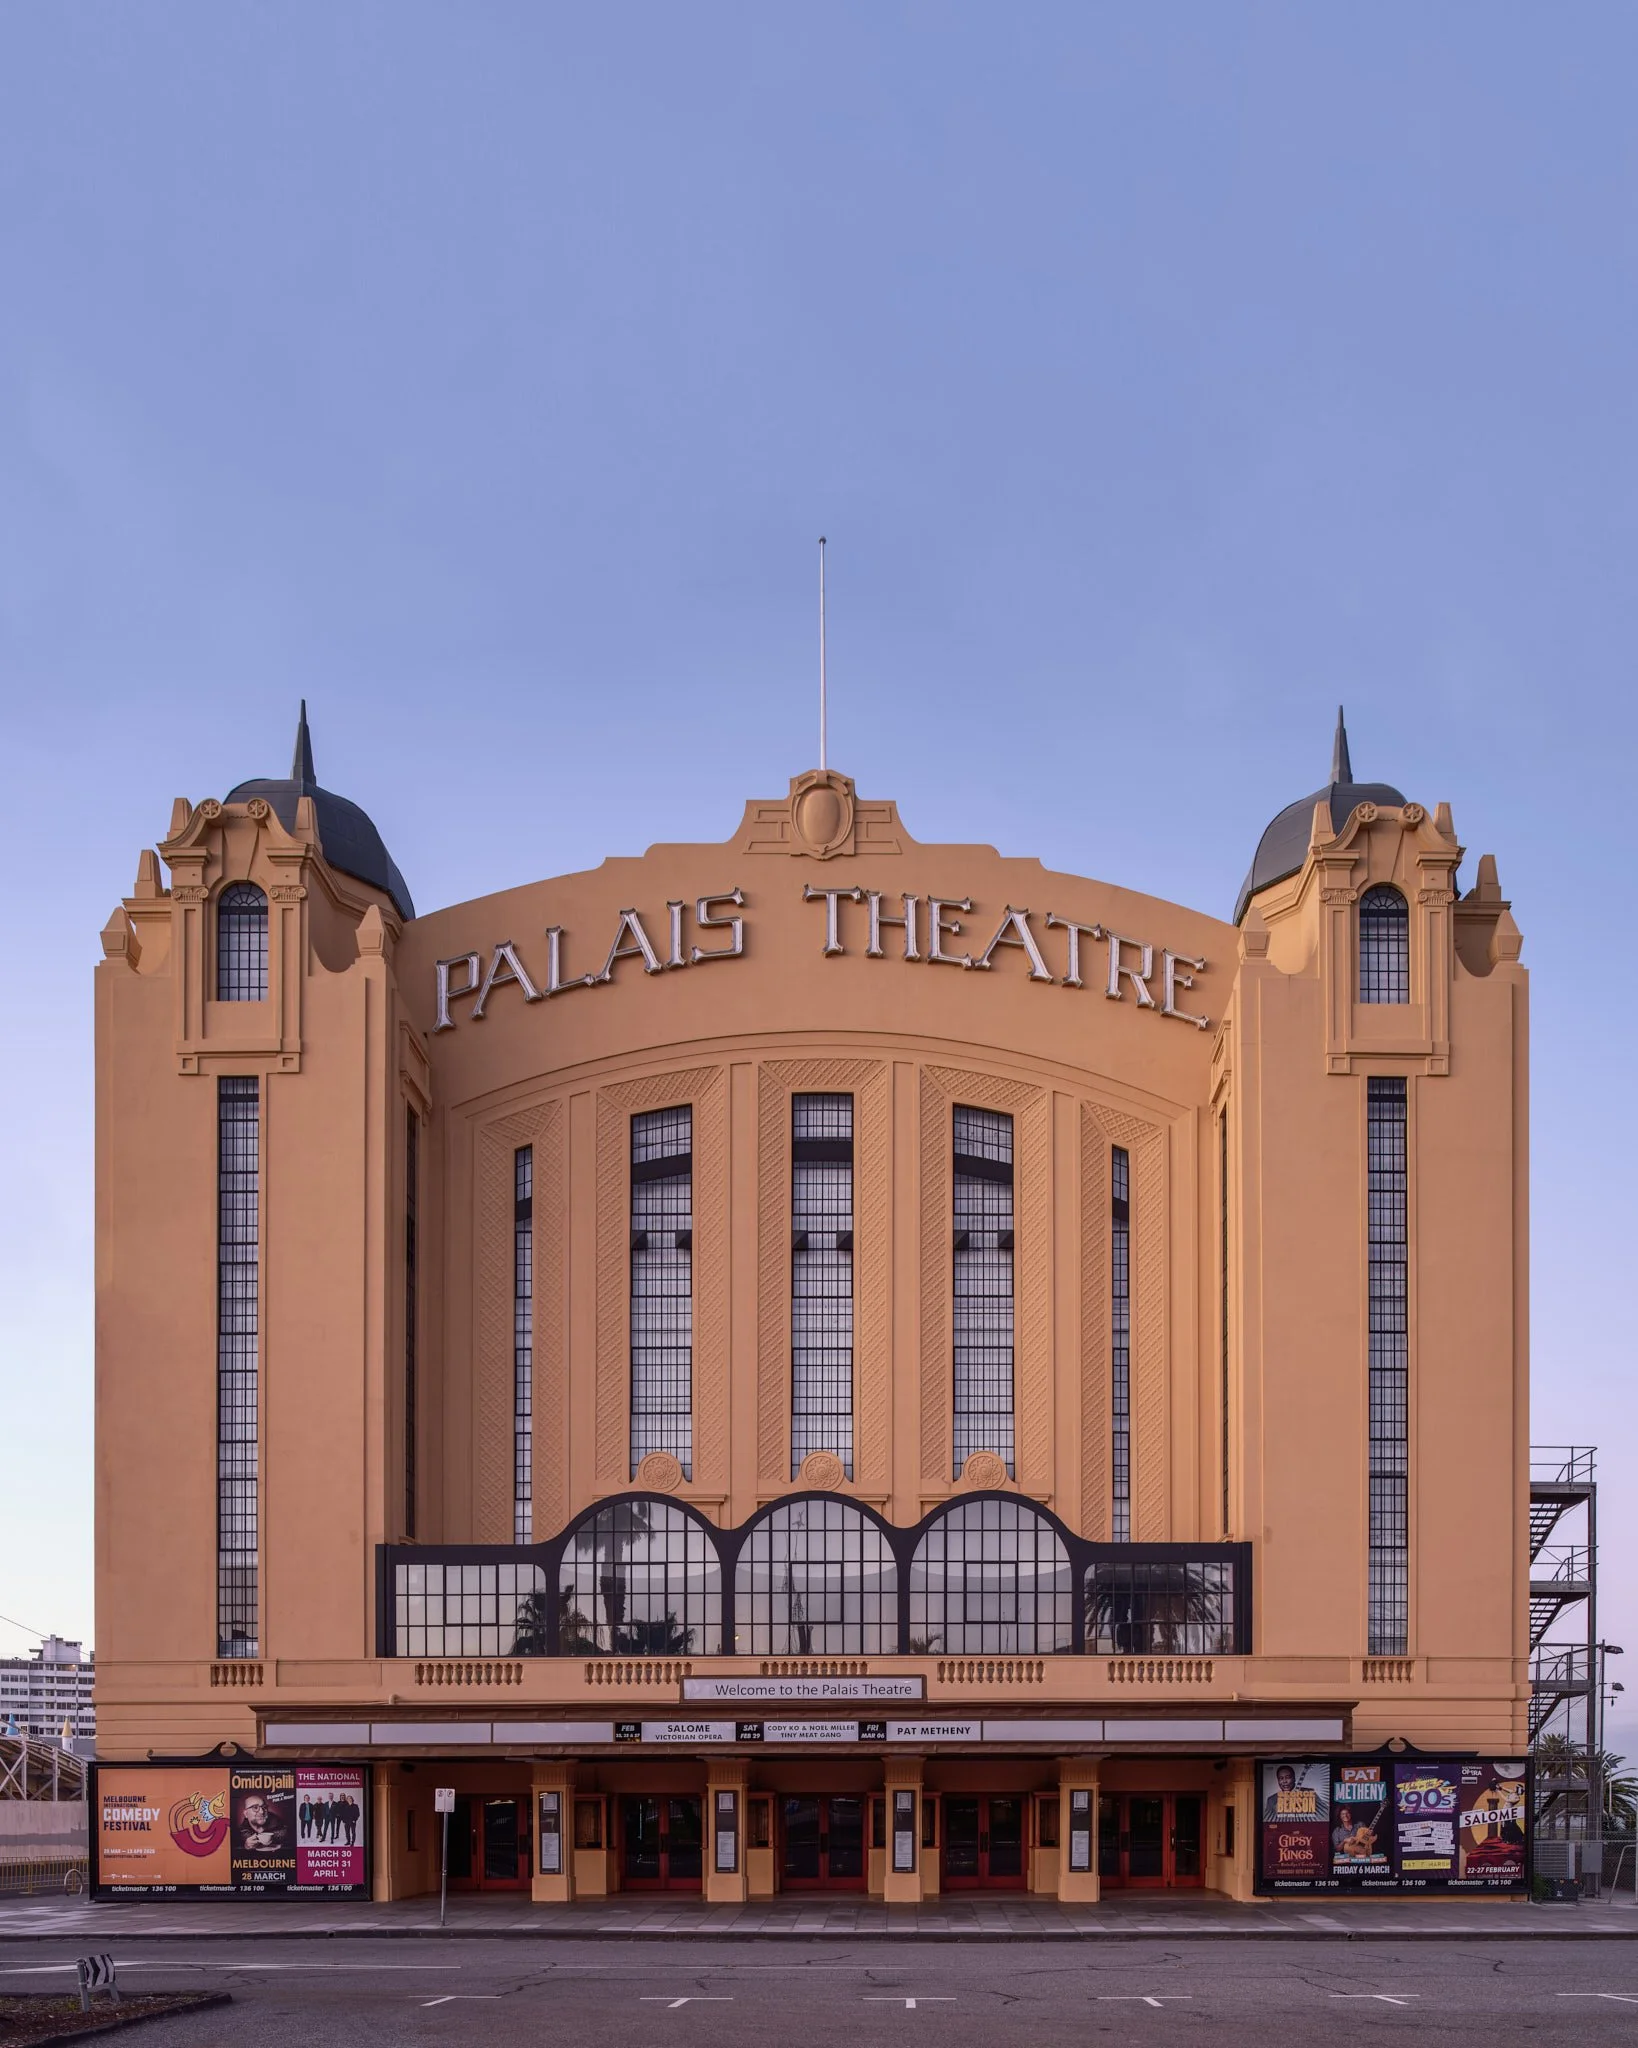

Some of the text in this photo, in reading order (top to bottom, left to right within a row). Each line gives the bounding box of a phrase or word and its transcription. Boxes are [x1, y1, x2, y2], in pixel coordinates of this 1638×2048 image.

[433, 883, 1210, 1034] PALAIS THEATRE
[715, 1684, 912, 1696] Welcome to the Palais Theatre
[667, 1724, 711, 1733] SALOME
[897, 1726, 971, 1735] PAT METHENY
[298, 1773, 315, 1781] THE
[1344, 1769, 1377, 1781] PAT
[231, 1774, 295, 1793] Omid Djalili
[1335, 1782, 1385, 1800] METHENY
[103, 1795, 147, 1803] MELBOURNE
[1277, 1797, 1316, 1813] BENSON
[103, 1808, 160, 1821] COMEDY
[1464, 1807, 1518, 1826] SALOME
[103, 1821, 152, 1831] FESTIVAL
[1278, 1834, 1313, 1848] GIPSY
[1278, 1847, 1314, 1862] KINGS
[232, 1859, 296, 1869] MELBOURNE
[1333, 1865, 1390, 1874] FRIDAY 6 MARCH
[241, 1872, 286, 1880] 28 MARCH
